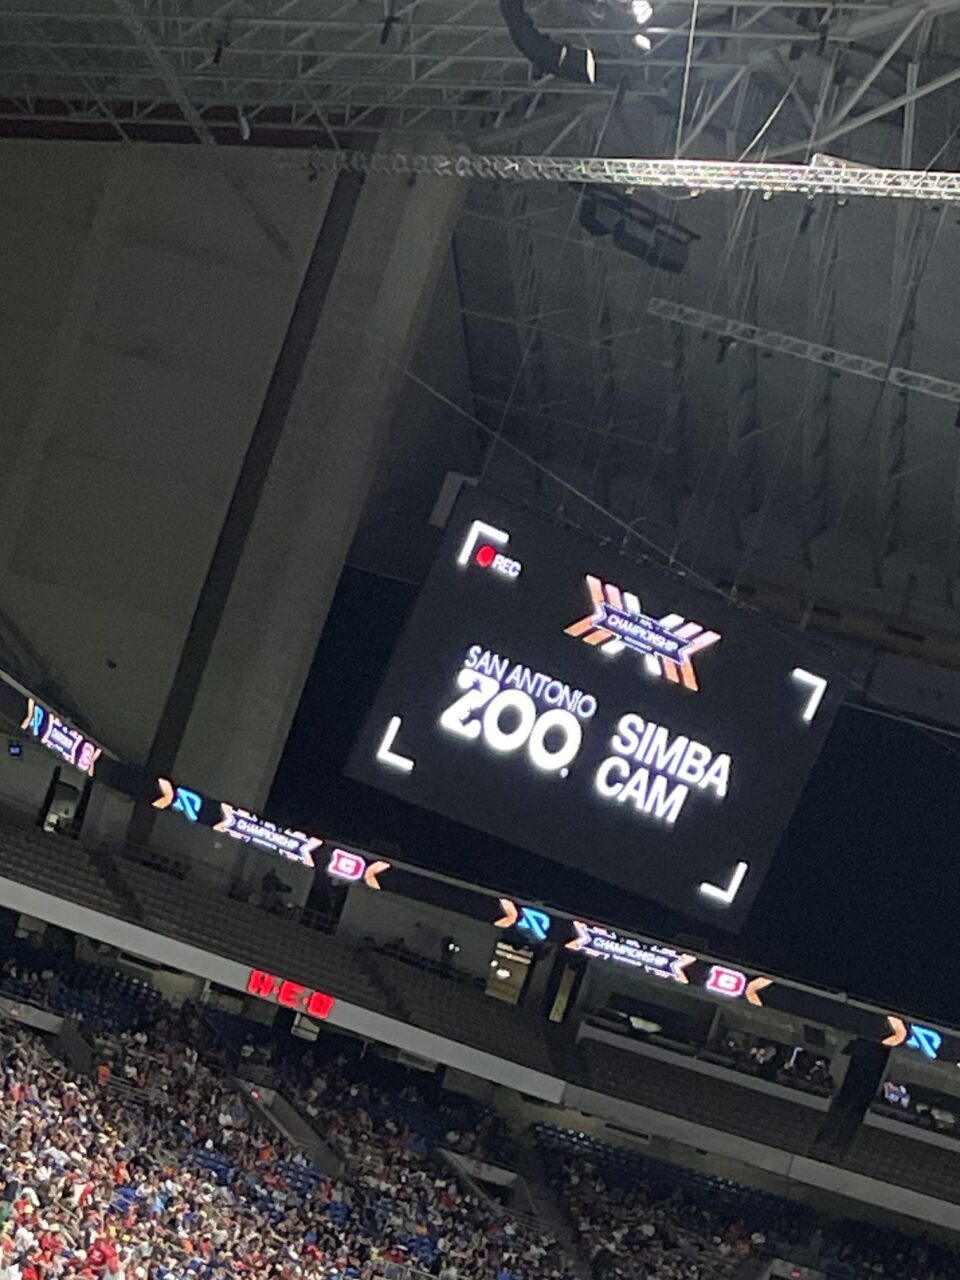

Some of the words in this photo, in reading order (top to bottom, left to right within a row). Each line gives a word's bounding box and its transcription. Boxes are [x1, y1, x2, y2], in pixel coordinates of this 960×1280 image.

[492, 553, 522, 577] REC
[607, 614, 679, 652] CHAMPIONSHIP
[464, 645, 510, 681] SAN
[505, 664, 598, 718] ANTONIO
[440, 668, 582, 771] ZOO
[596, 756, 689, 823] CAM
[612, 713, 731, 797] SIMBA
